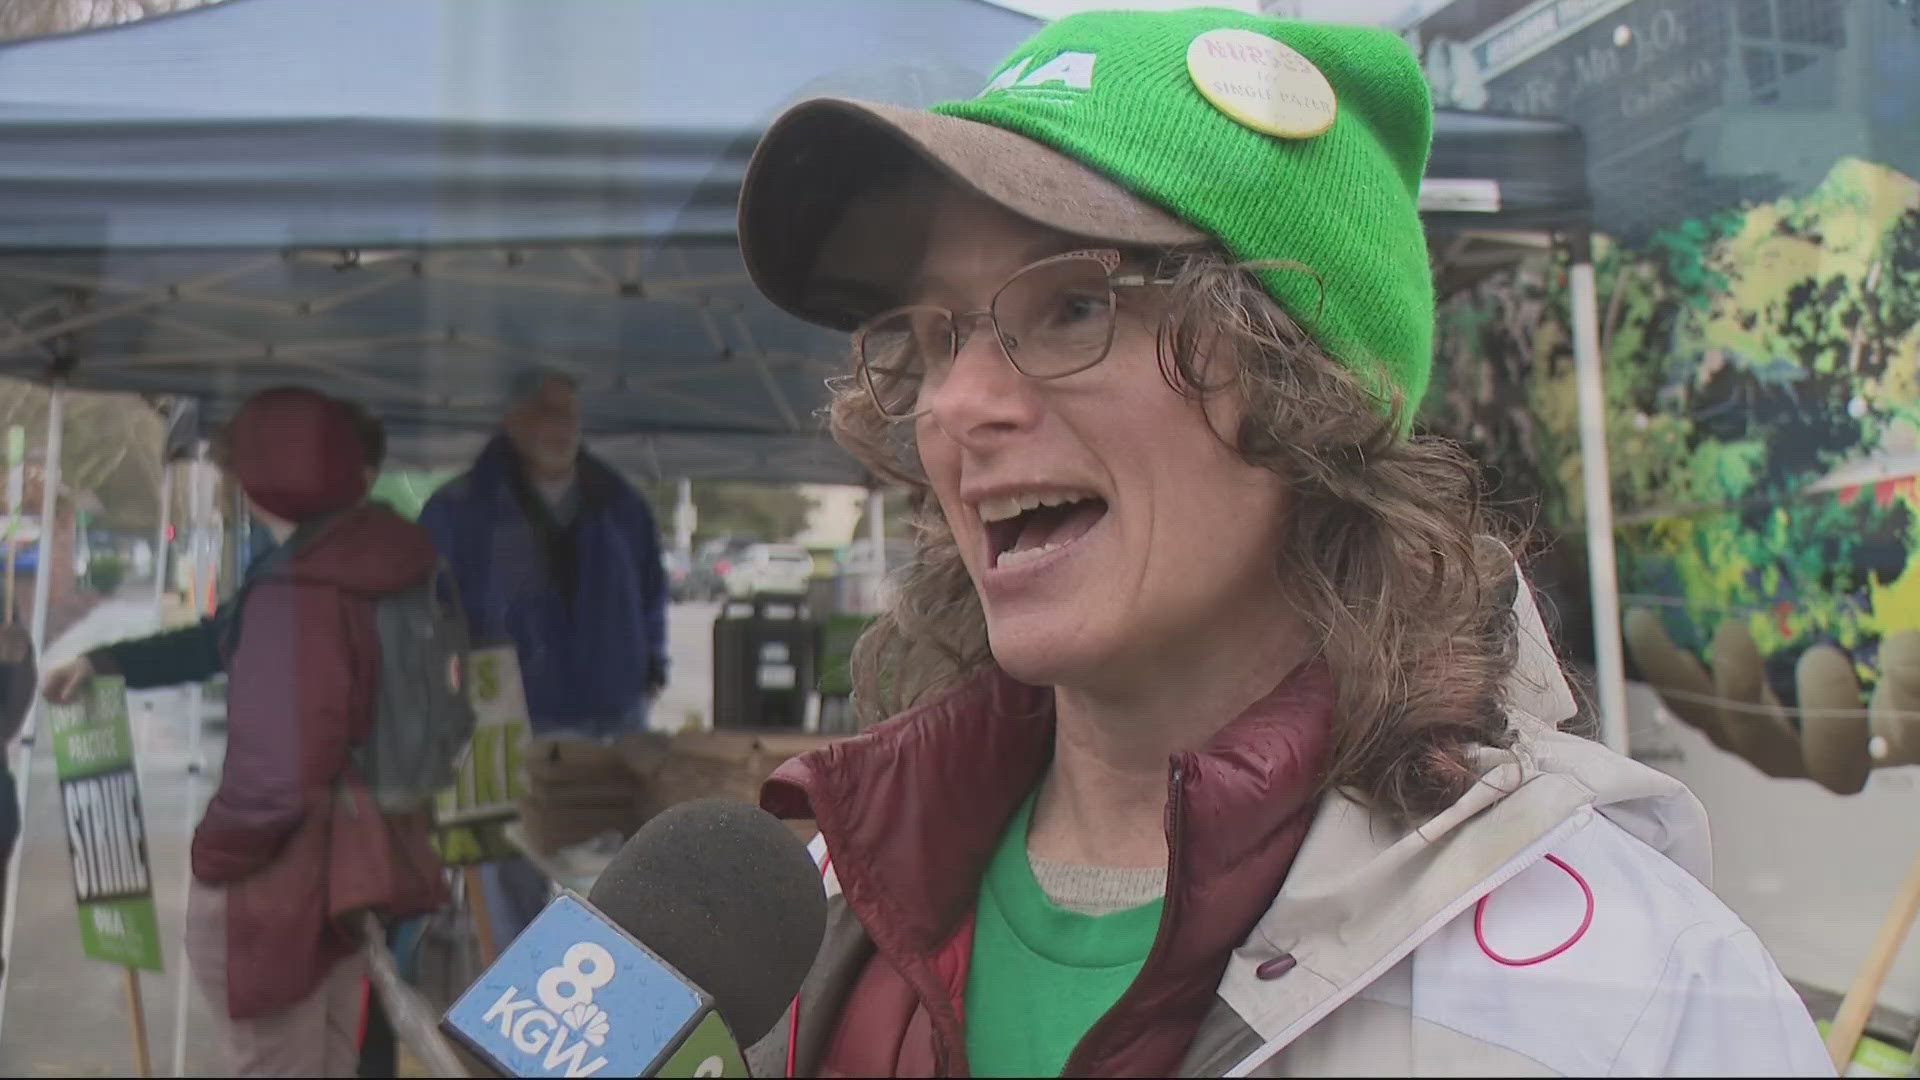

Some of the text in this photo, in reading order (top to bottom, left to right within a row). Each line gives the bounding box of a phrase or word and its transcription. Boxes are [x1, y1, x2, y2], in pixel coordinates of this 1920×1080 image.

[1213, 81, 1272, 100] SINGLE
[64, 771, 148, 899] STRIKE
[537, 942, 615, 1014] 8
[482, 985, 608, 1078] KGW
